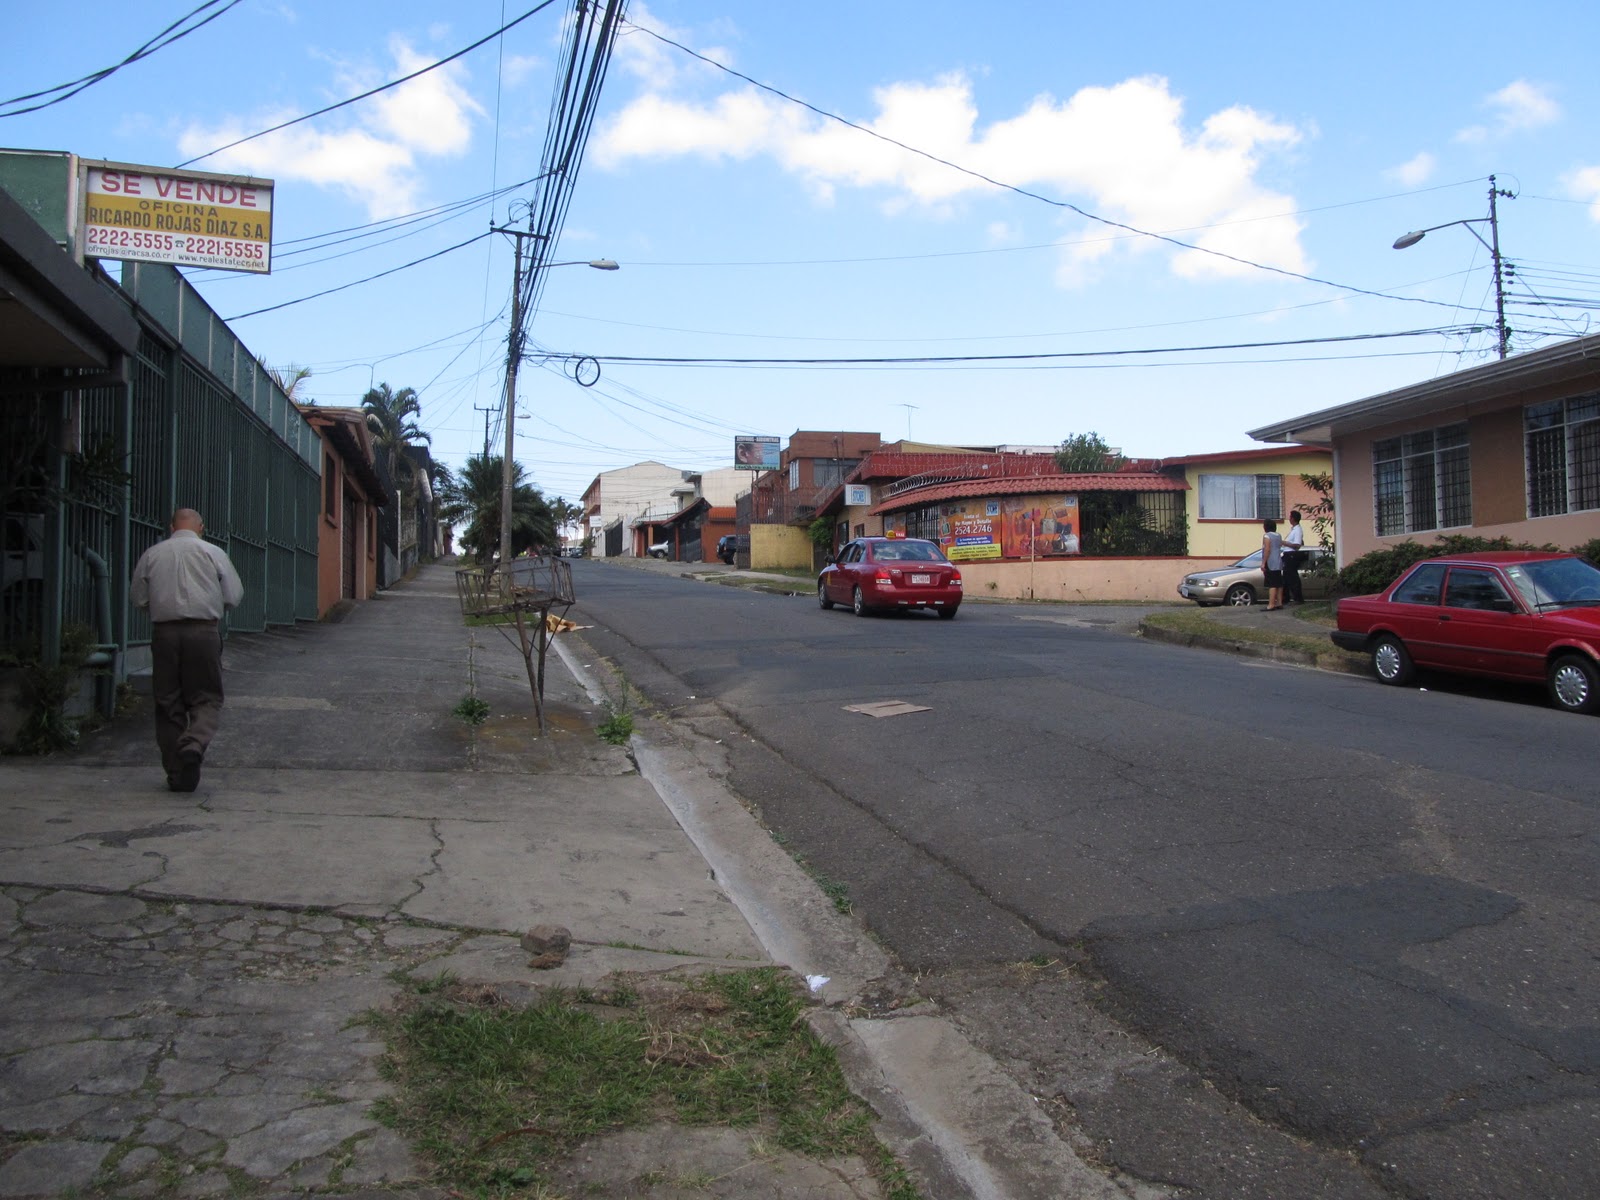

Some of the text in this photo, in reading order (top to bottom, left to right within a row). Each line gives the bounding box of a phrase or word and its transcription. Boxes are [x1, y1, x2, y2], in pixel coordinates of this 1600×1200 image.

[101, 172, 257, 207] SE VENDE
[89, 207, 267, 240] RICARDO ROJAS DIAZ S.A.
[139, 200, 218, 218] OFICINA
[88, 228, 263, 260] 2222-5555 2221-5555
